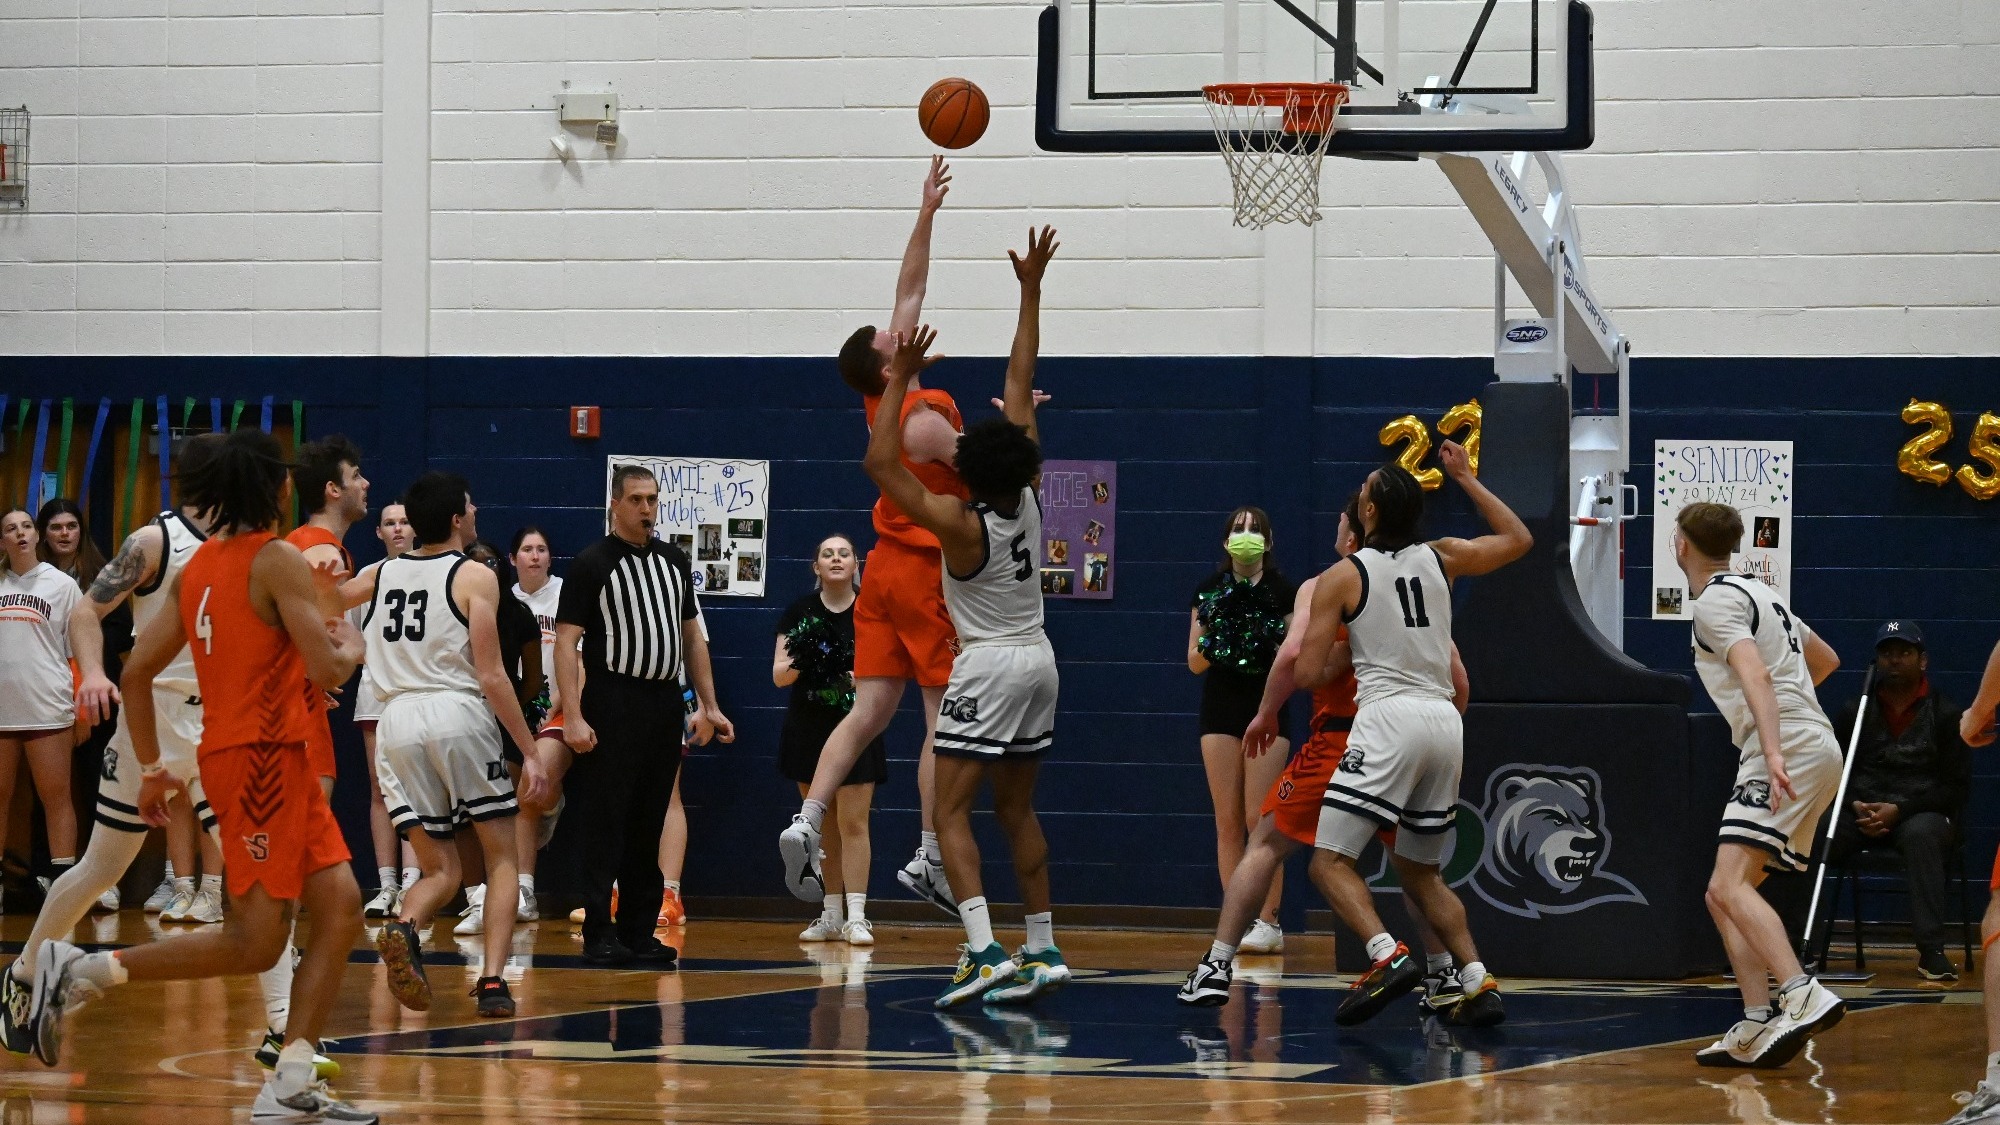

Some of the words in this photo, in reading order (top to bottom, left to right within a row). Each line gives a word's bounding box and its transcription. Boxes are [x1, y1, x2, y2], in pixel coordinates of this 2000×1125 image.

[1494, 159, 1529, 214] LEGACY
[1573, 280, 1608, 336] SPORTS
[1679, 446, 1772, 485] SENIOR
[1898, 398, 2000, 500] 25
[659, 496, 706, 530] ruble
[708, 479, 754, 513] #25
[1683, 487, 1700, 501] 20
[1707, 486, 1735, 504] DAY
[1740, 487, 1758, 501] 24
[1010, 530, 1033, 582] 5
[1743, 560, 1772, 573] JAMIE
[195, 586, 212, 655] 4
[383, 588, 429, 642] 33
[1394, 576, 1430, 628] 11
[1772, 602, 1801, 654] 2
